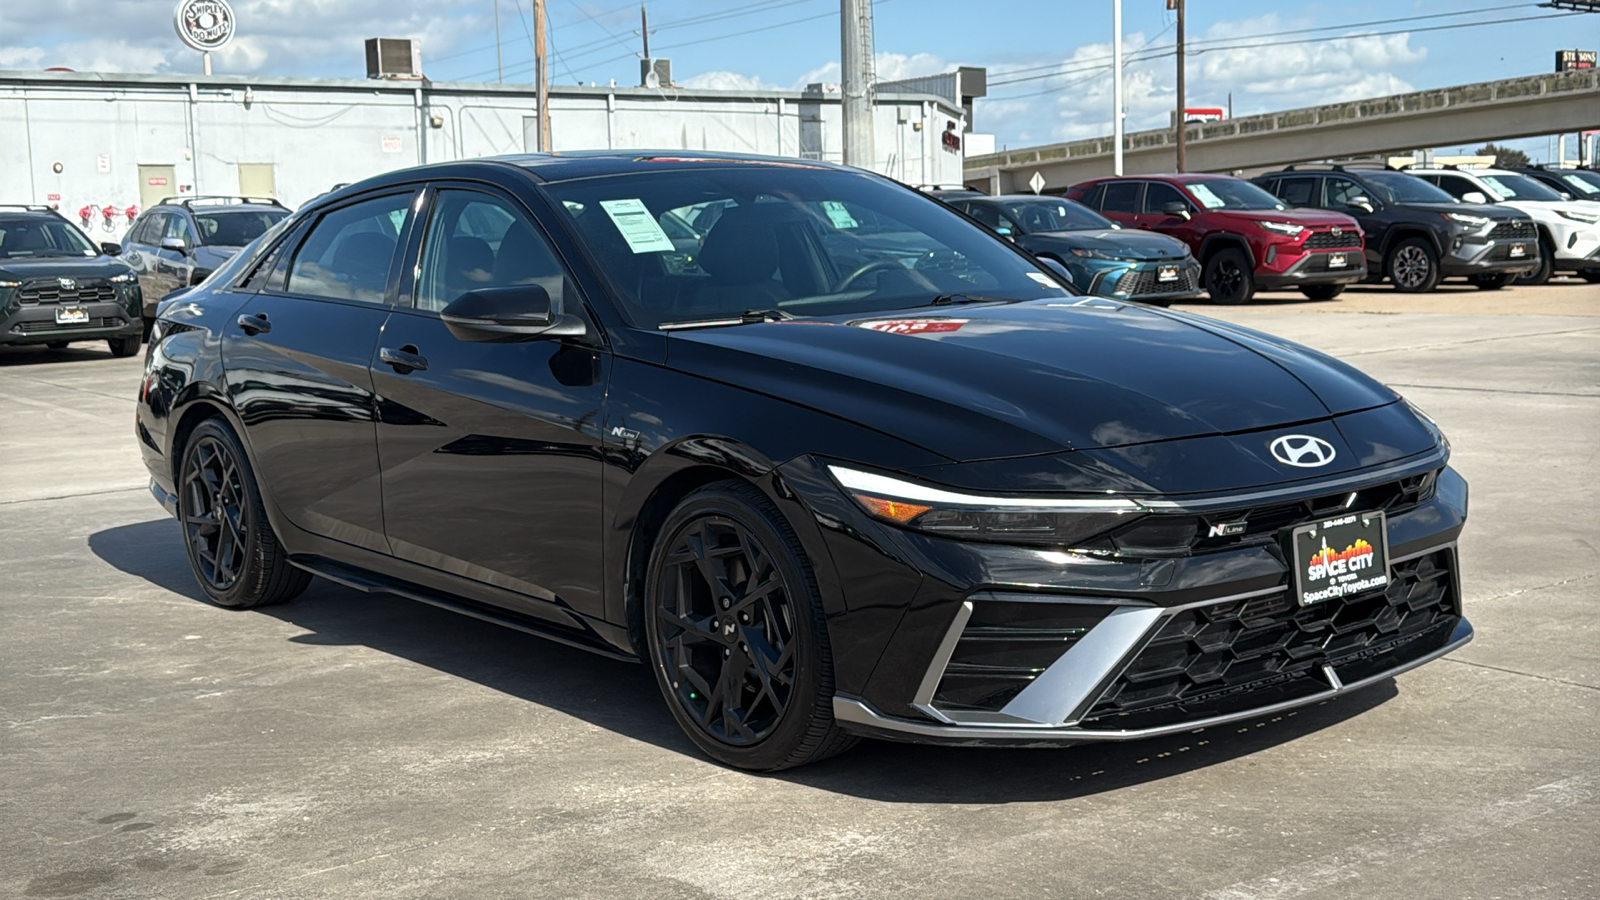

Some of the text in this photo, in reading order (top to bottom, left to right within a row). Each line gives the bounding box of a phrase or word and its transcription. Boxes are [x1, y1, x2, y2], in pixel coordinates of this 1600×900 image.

[187, 3, 224, 19] SHIPLEY
[1563, 51, 1596, 62] STESONS
[1308, 552, 1374, 581] SPACE CITY
[1337, 573, 1358, 583] TOYOTA
[1303, 575, 1387, 604] SpaceCityToyota.com
